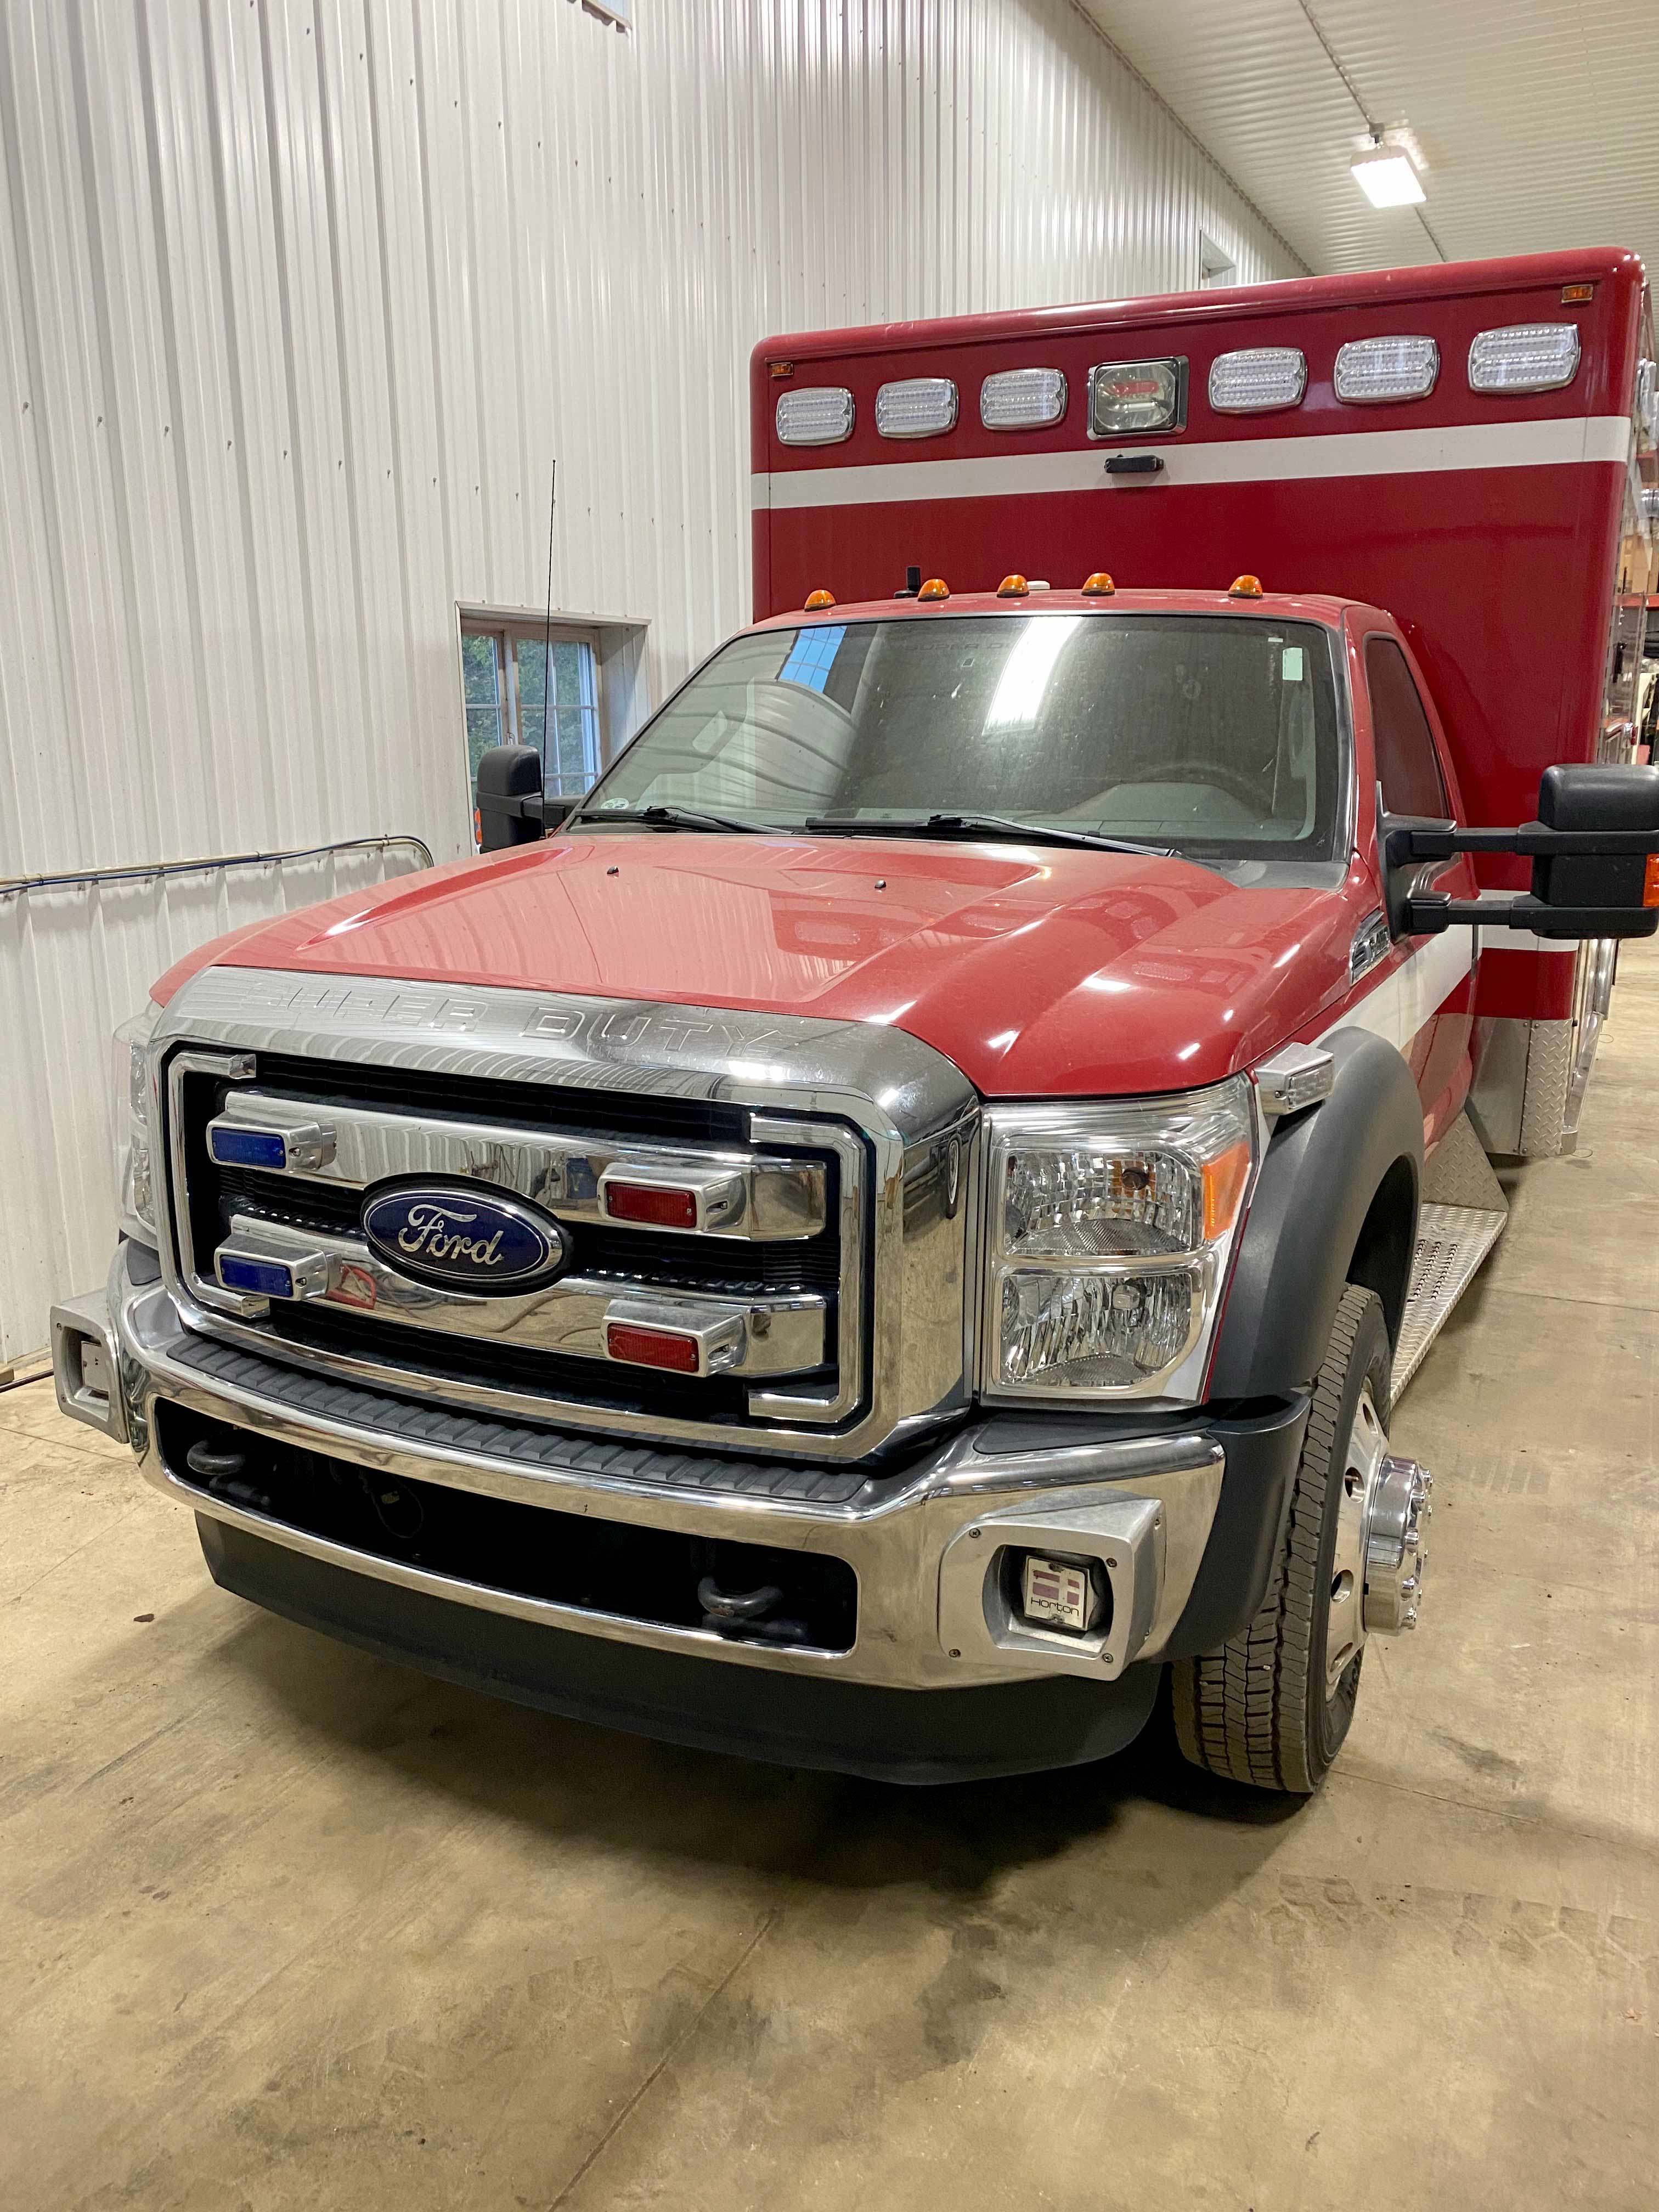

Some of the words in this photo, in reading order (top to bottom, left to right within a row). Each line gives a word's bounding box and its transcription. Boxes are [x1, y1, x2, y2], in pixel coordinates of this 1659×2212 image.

[242, 983, 488, 1031] SUPER
[518, 1006, 779, 1057] DUTY
[398, 1204, 504, 1265] Ford
[1030, 1597, 1079, 1617] Horton
